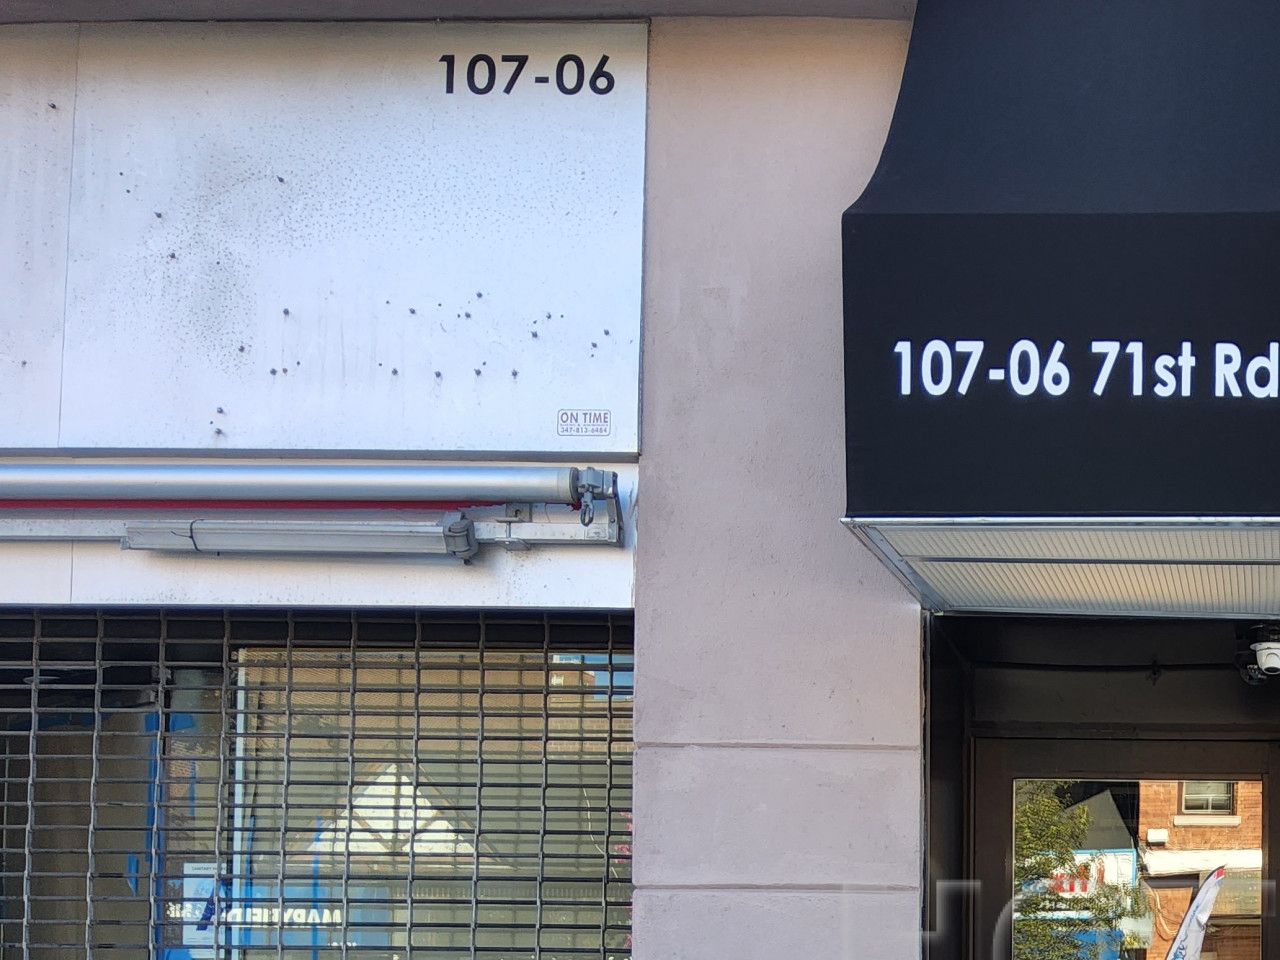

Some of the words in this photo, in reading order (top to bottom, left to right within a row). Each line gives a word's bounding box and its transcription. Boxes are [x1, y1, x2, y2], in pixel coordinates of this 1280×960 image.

[438, 53, 615, 95] 107-06
[894, 339, 1070, 396] 107-06
[1091, 341, 1196, 397] 71st
[560, 412, 579, 423] ON
[582, 412, 609, 423] TIME
